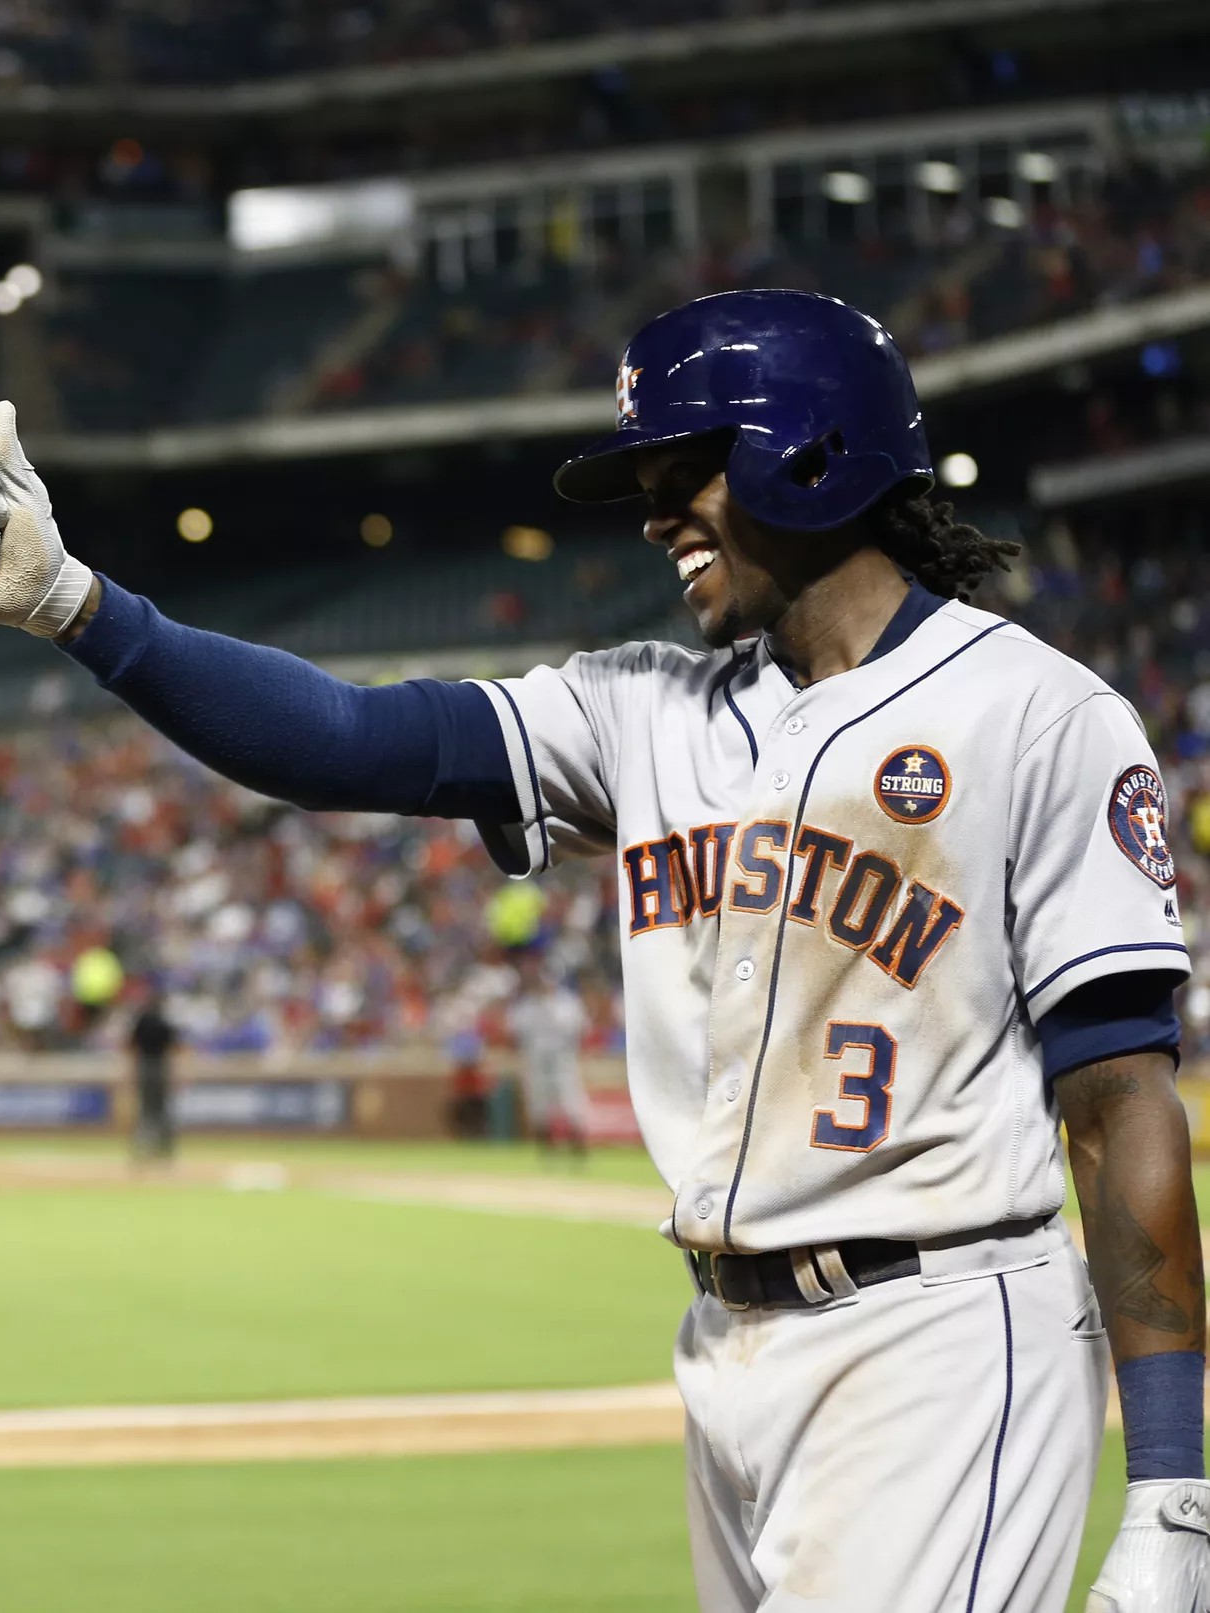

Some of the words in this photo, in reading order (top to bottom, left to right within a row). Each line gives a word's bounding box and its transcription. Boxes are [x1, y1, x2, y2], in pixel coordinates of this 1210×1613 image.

[881, 775, 944, 795] STRONG
[622, 819, 966, 991] HOUSTON
[809, 1019, 898, 1154] 3
